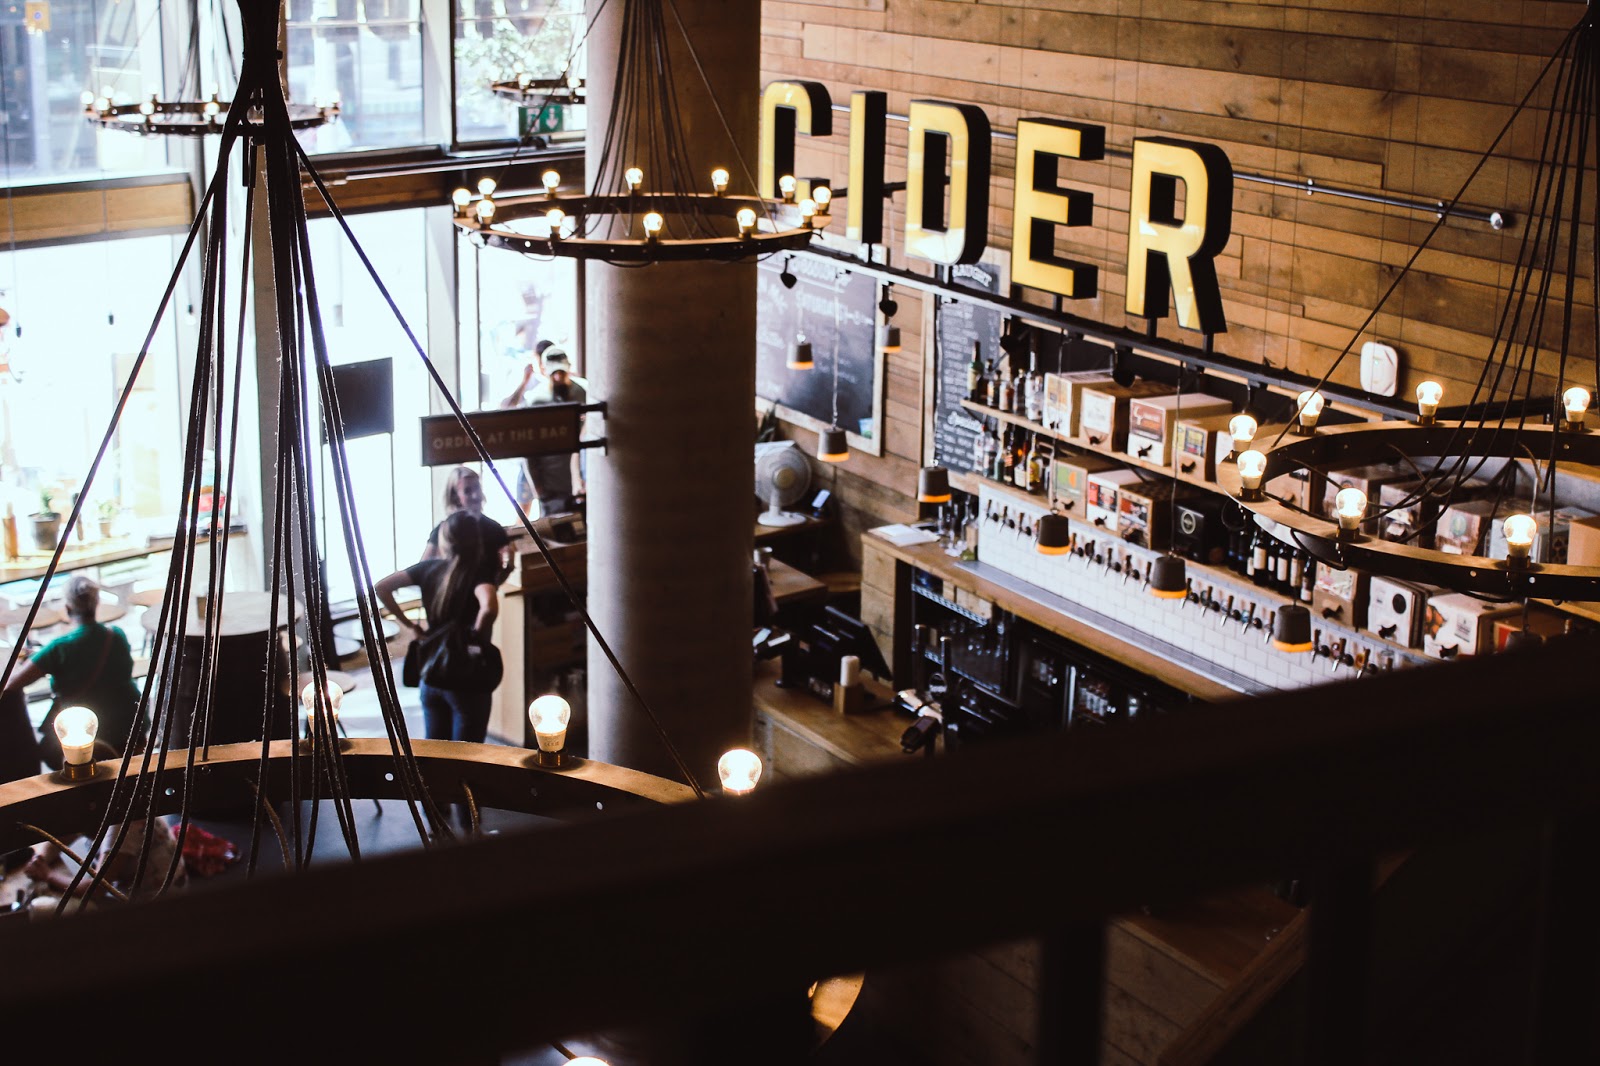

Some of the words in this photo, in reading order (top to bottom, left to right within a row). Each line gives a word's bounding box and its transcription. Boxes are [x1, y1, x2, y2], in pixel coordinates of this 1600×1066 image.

[758, 79, 1234, 334] CIDER
[432, 433, 480, 450] ORDE
[486, 431, 505, 445] AT
[510, 428, 535, 442] THE
[540, 425, 568, 440] BAR
